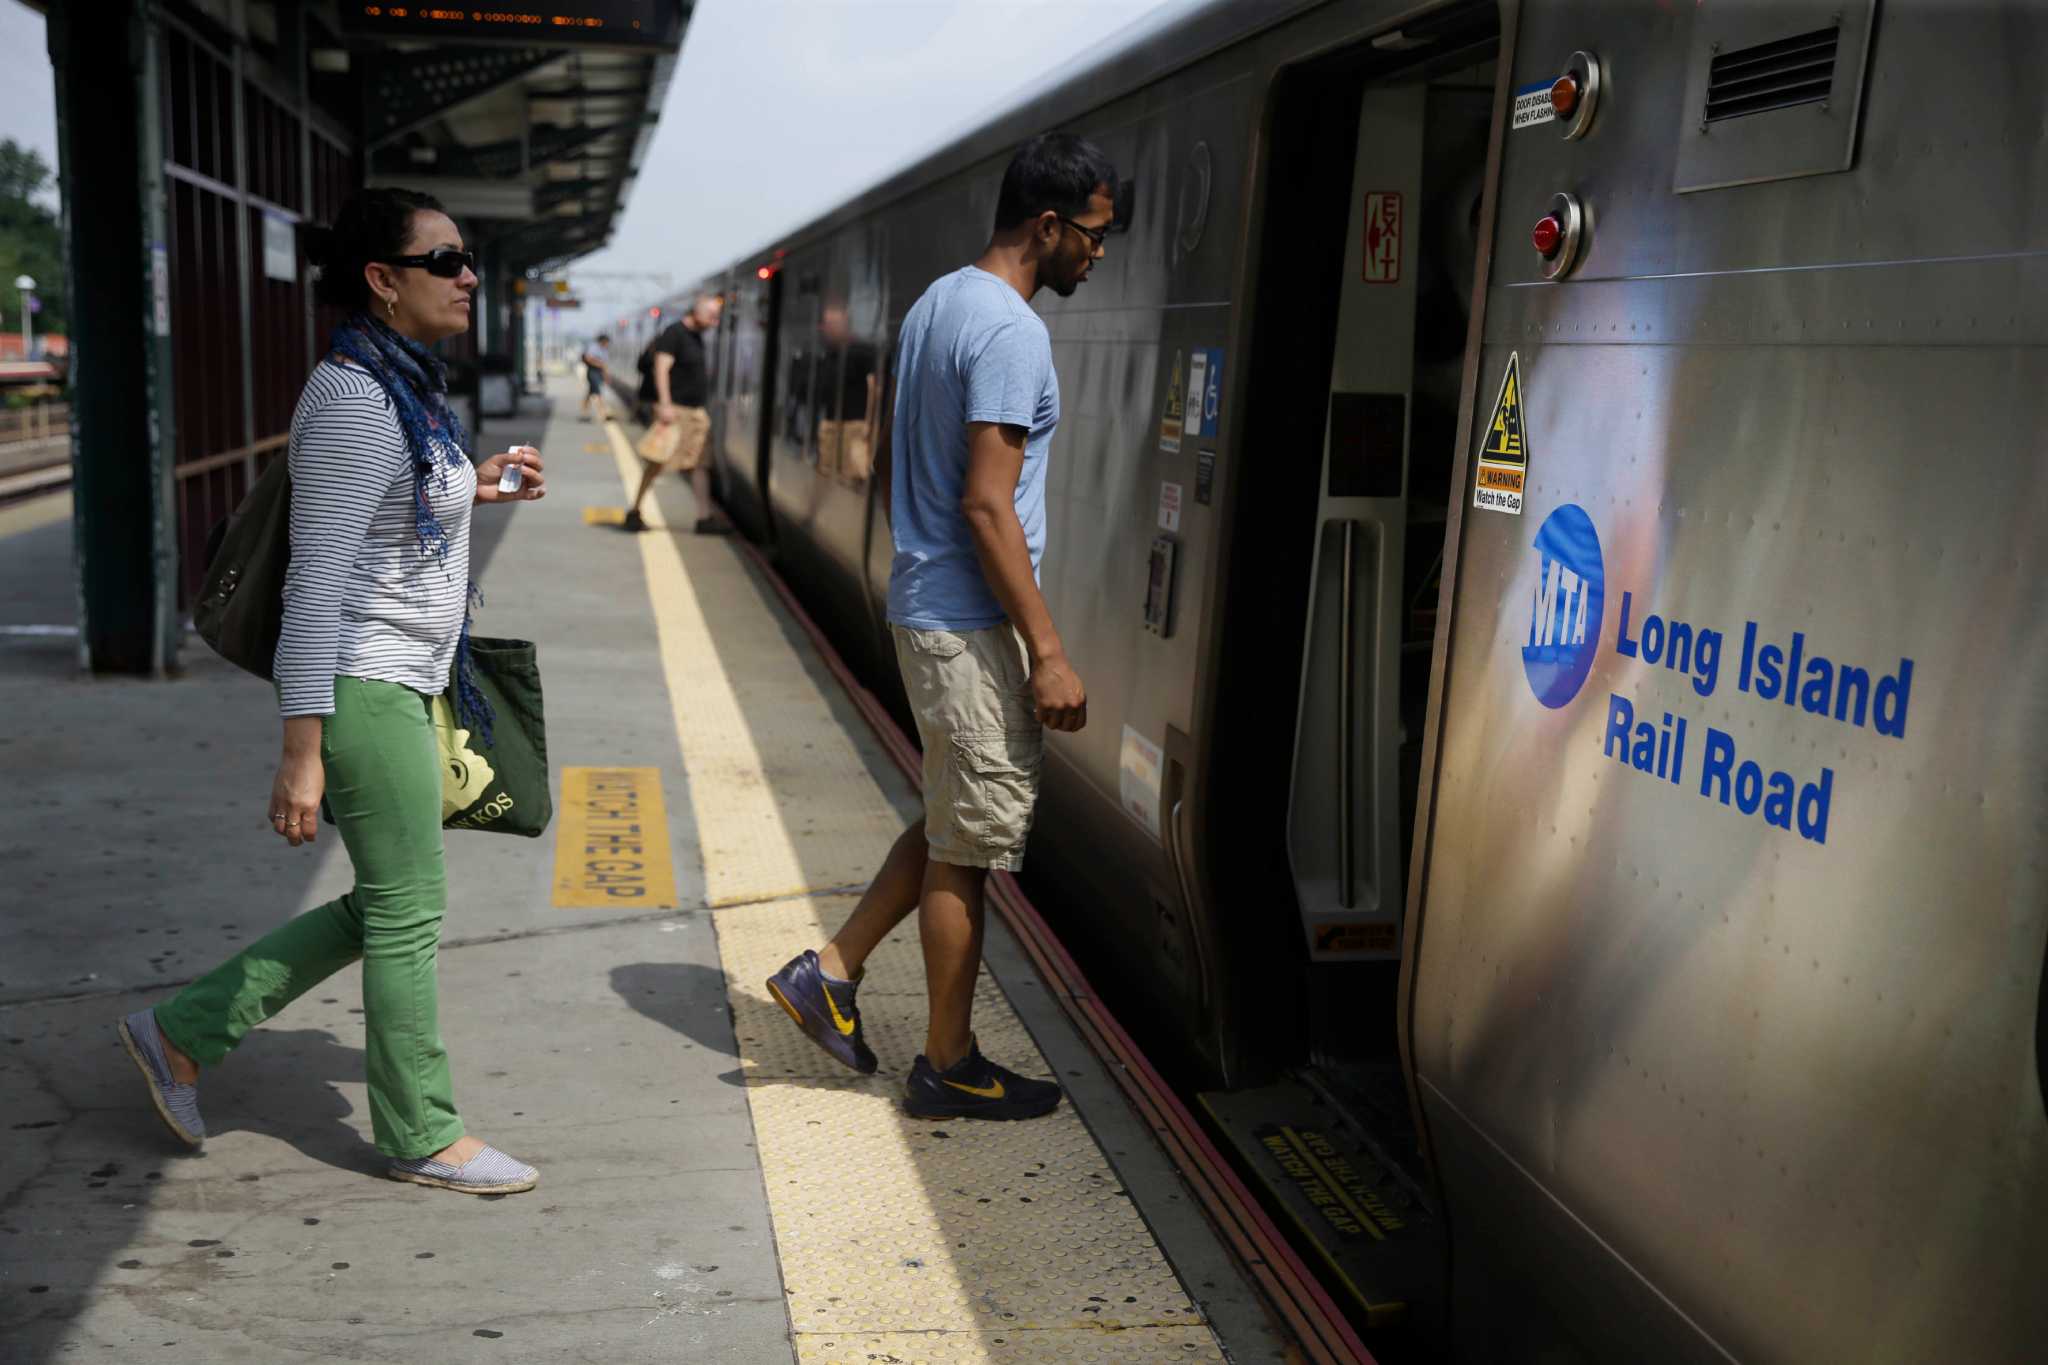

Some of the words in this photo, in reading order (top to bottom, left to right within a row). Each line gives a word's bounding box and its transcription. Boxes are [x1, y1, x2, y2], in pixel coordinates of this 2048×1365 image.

[1514, 112, 1530, 125] WHEN
[1530, 106, 1553, 120] FLASHIN
[1516, 97, 1531, 111] DOOR
[1532, 92, 1552, 106] DISABL
[1379, 195, 1397, 279] EXIT
[1476, 489, 1495, 505] Watch
[1496, 493, 1506, 507] the
[1507, 494, 1521, 512] Gap
[1487, 471, 1521, 489] WARNING
[1522, 548, 1589, 648] MTA
[1616, 591, 1722, 697] Long
[1738, 621, 1914, 740] Island
[1604, 693, 1687, 786] Rail
[1700, 727, 1834, 845] Road
[586, 772, 640, 821] WATCH
[586, 825, 642, 855] THE
[585, 860, 646, 898] GAP
[1263, 1134, 1317, 1179] WATCH
[1299, 1180, 1337, 1208] THE
[1320, 1207, 1361, 1234] GAP
